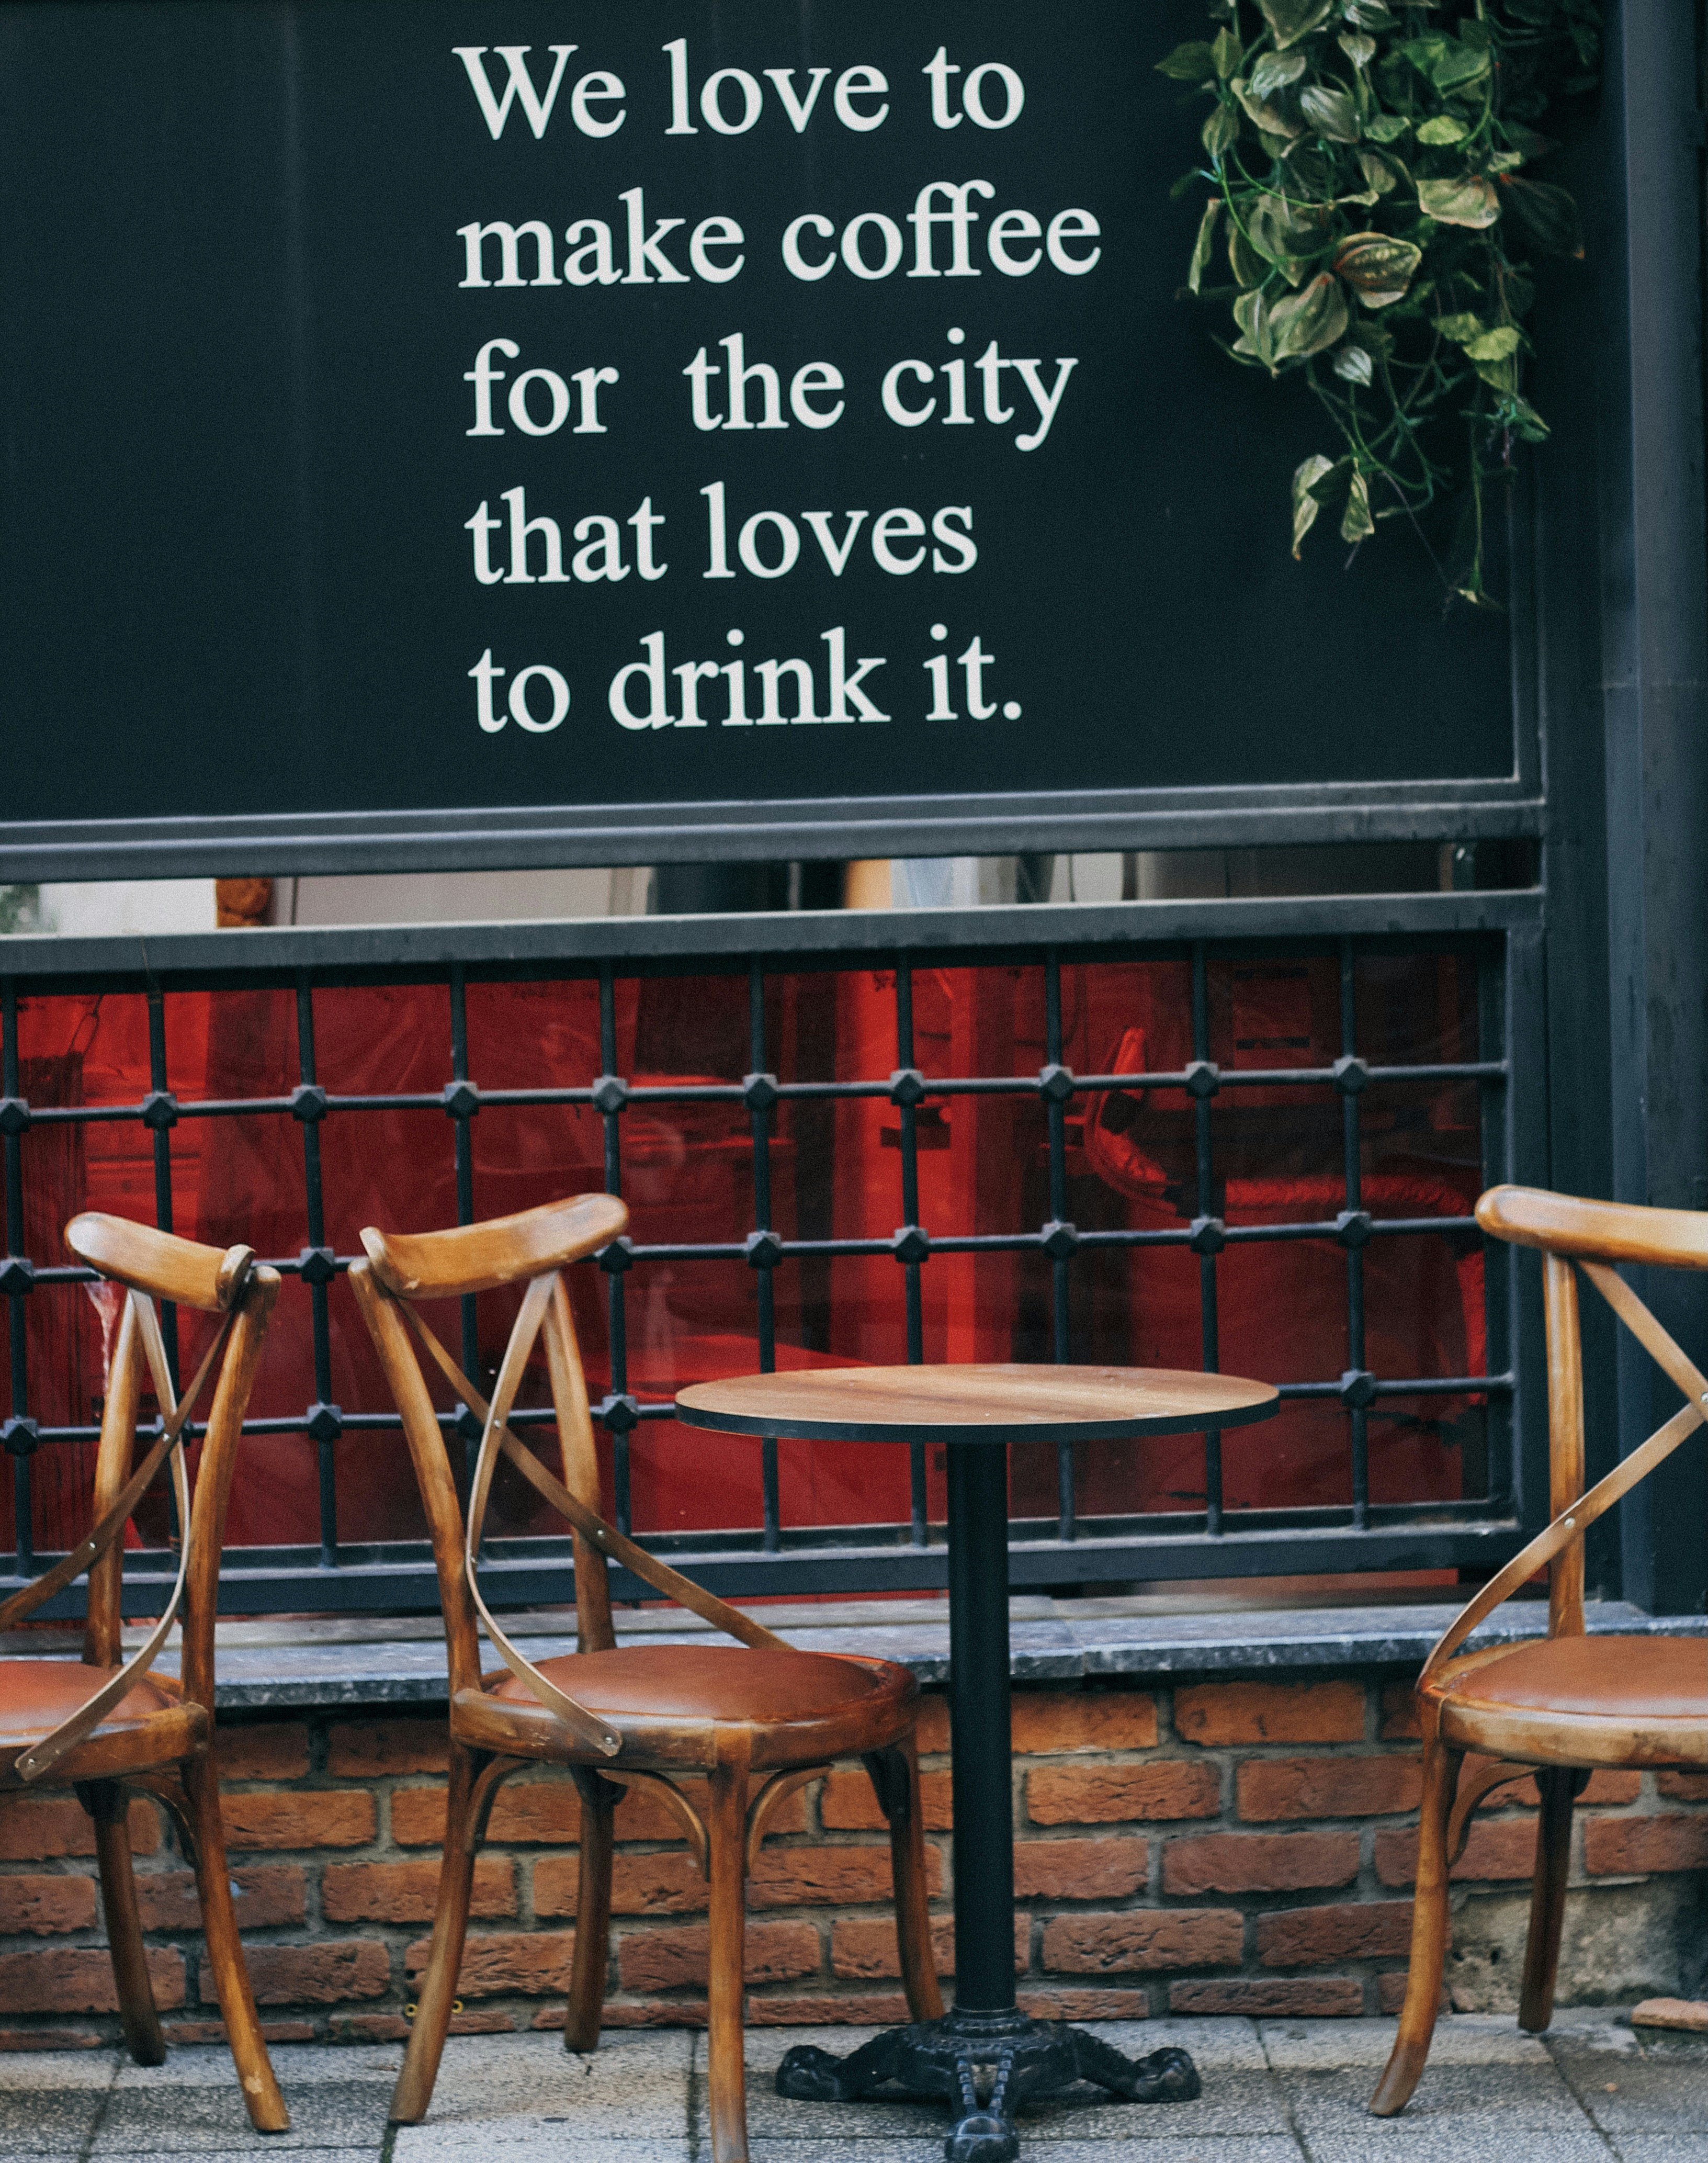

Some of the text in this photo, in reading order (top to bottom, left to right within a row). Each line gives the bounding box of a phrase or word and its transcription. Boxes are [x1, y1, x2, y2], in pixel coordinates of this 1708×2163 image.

[451, 37, 1025, 141] We love to
[456, 178, 1102, 288] make coffee
[462, 326, 1079, 452] for the city
[463, 480, 978, 585] that loves
[467, 623, 1022, 734] to drink it.
